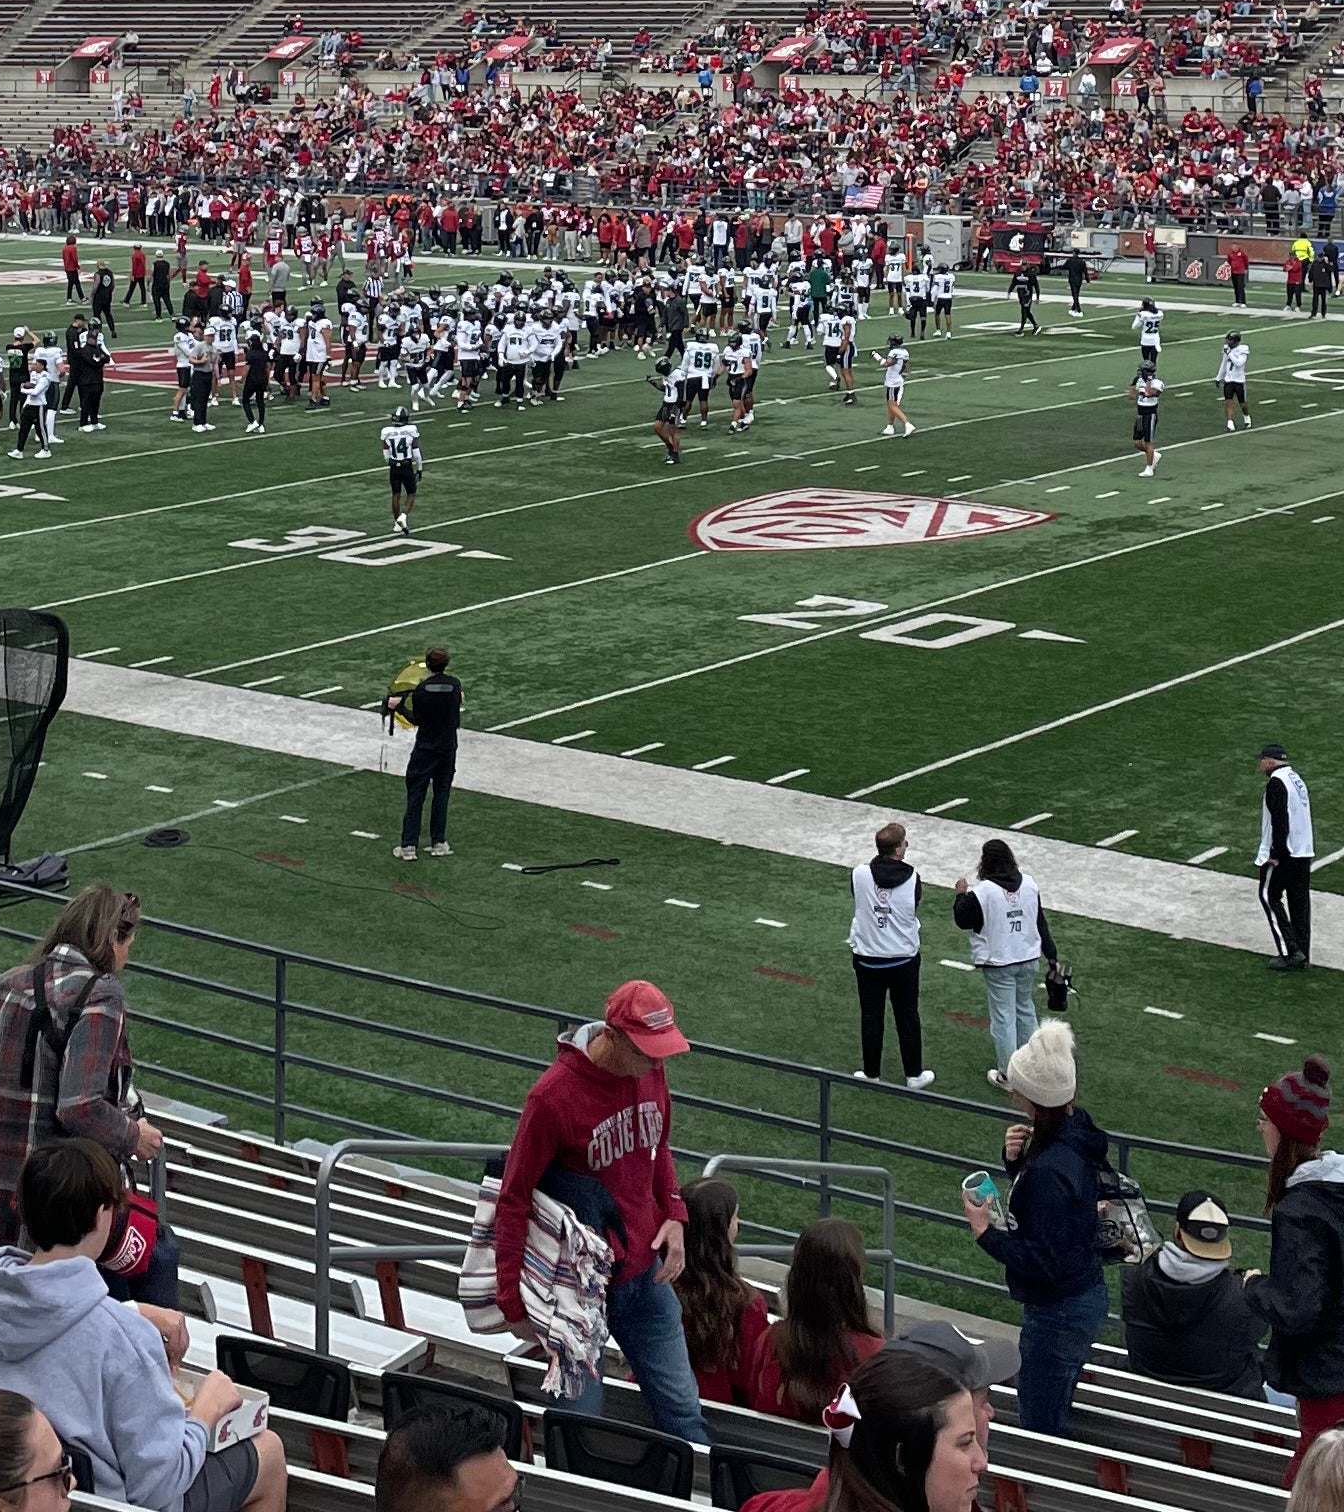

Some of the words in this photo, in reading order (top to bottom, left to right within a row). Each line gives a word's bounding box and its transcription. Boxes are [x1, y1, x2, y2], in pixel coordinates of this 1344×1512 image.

[1049, 84, 1064, 97] 27
[694, 351, 713, 369] 69
[388, 438, 409, 459] 14
[227, 525, 464, 566] 30
[737, 594, 1017, 650] 20
[1009, 920, 1022, 933] 70
[587, 1111, 663, 1171] COUGARS
